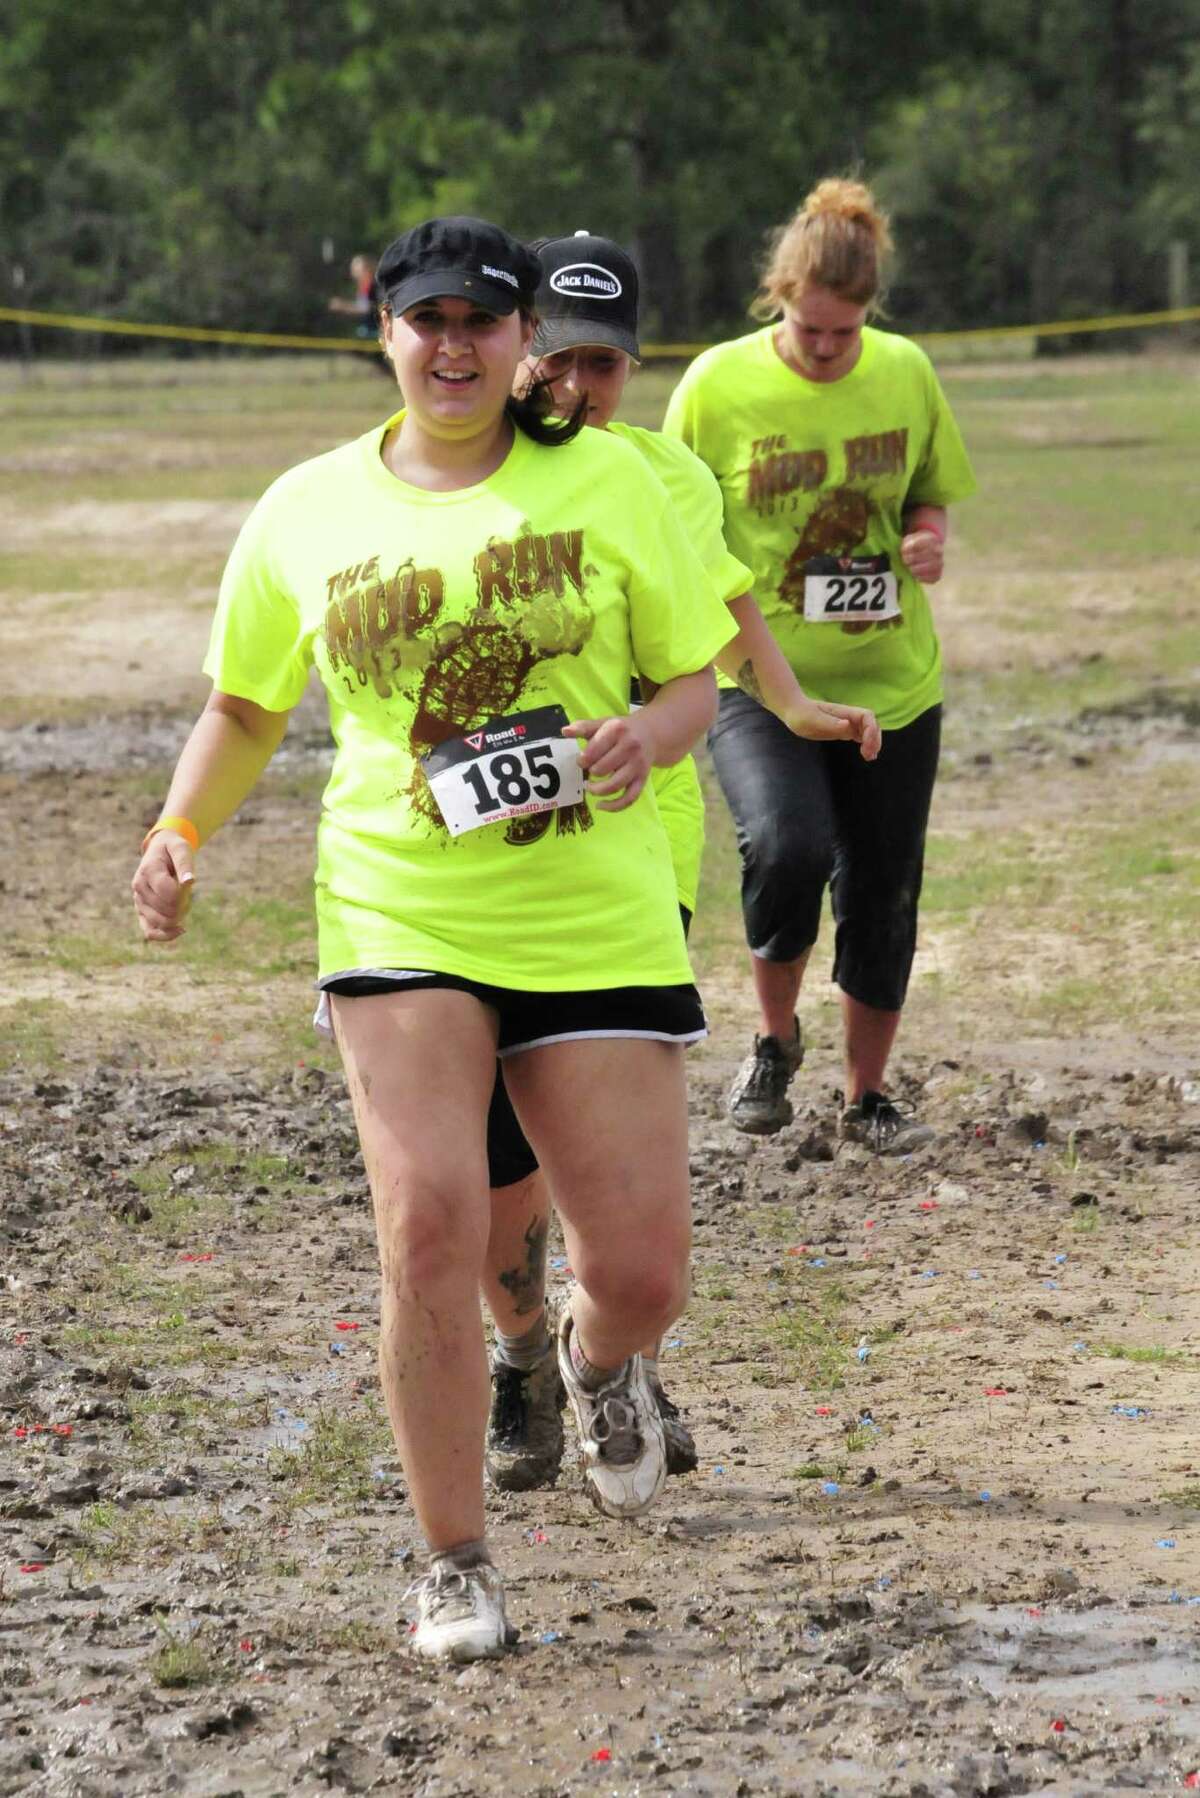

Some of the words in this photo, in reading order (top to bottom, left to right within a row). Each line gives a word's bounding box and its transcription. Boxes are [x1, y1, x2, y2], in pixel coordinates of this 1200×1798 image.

[751, 434, 787, 458] THE
[844, 427, 908, 481] RUN
[326, 566, 445, 662] MUD
[474, 529, 584, 608] RUN
[327, 555, 380, 602] THE
[824, 576, 887, 612] 222
[462, 744, 561, 815] 185
